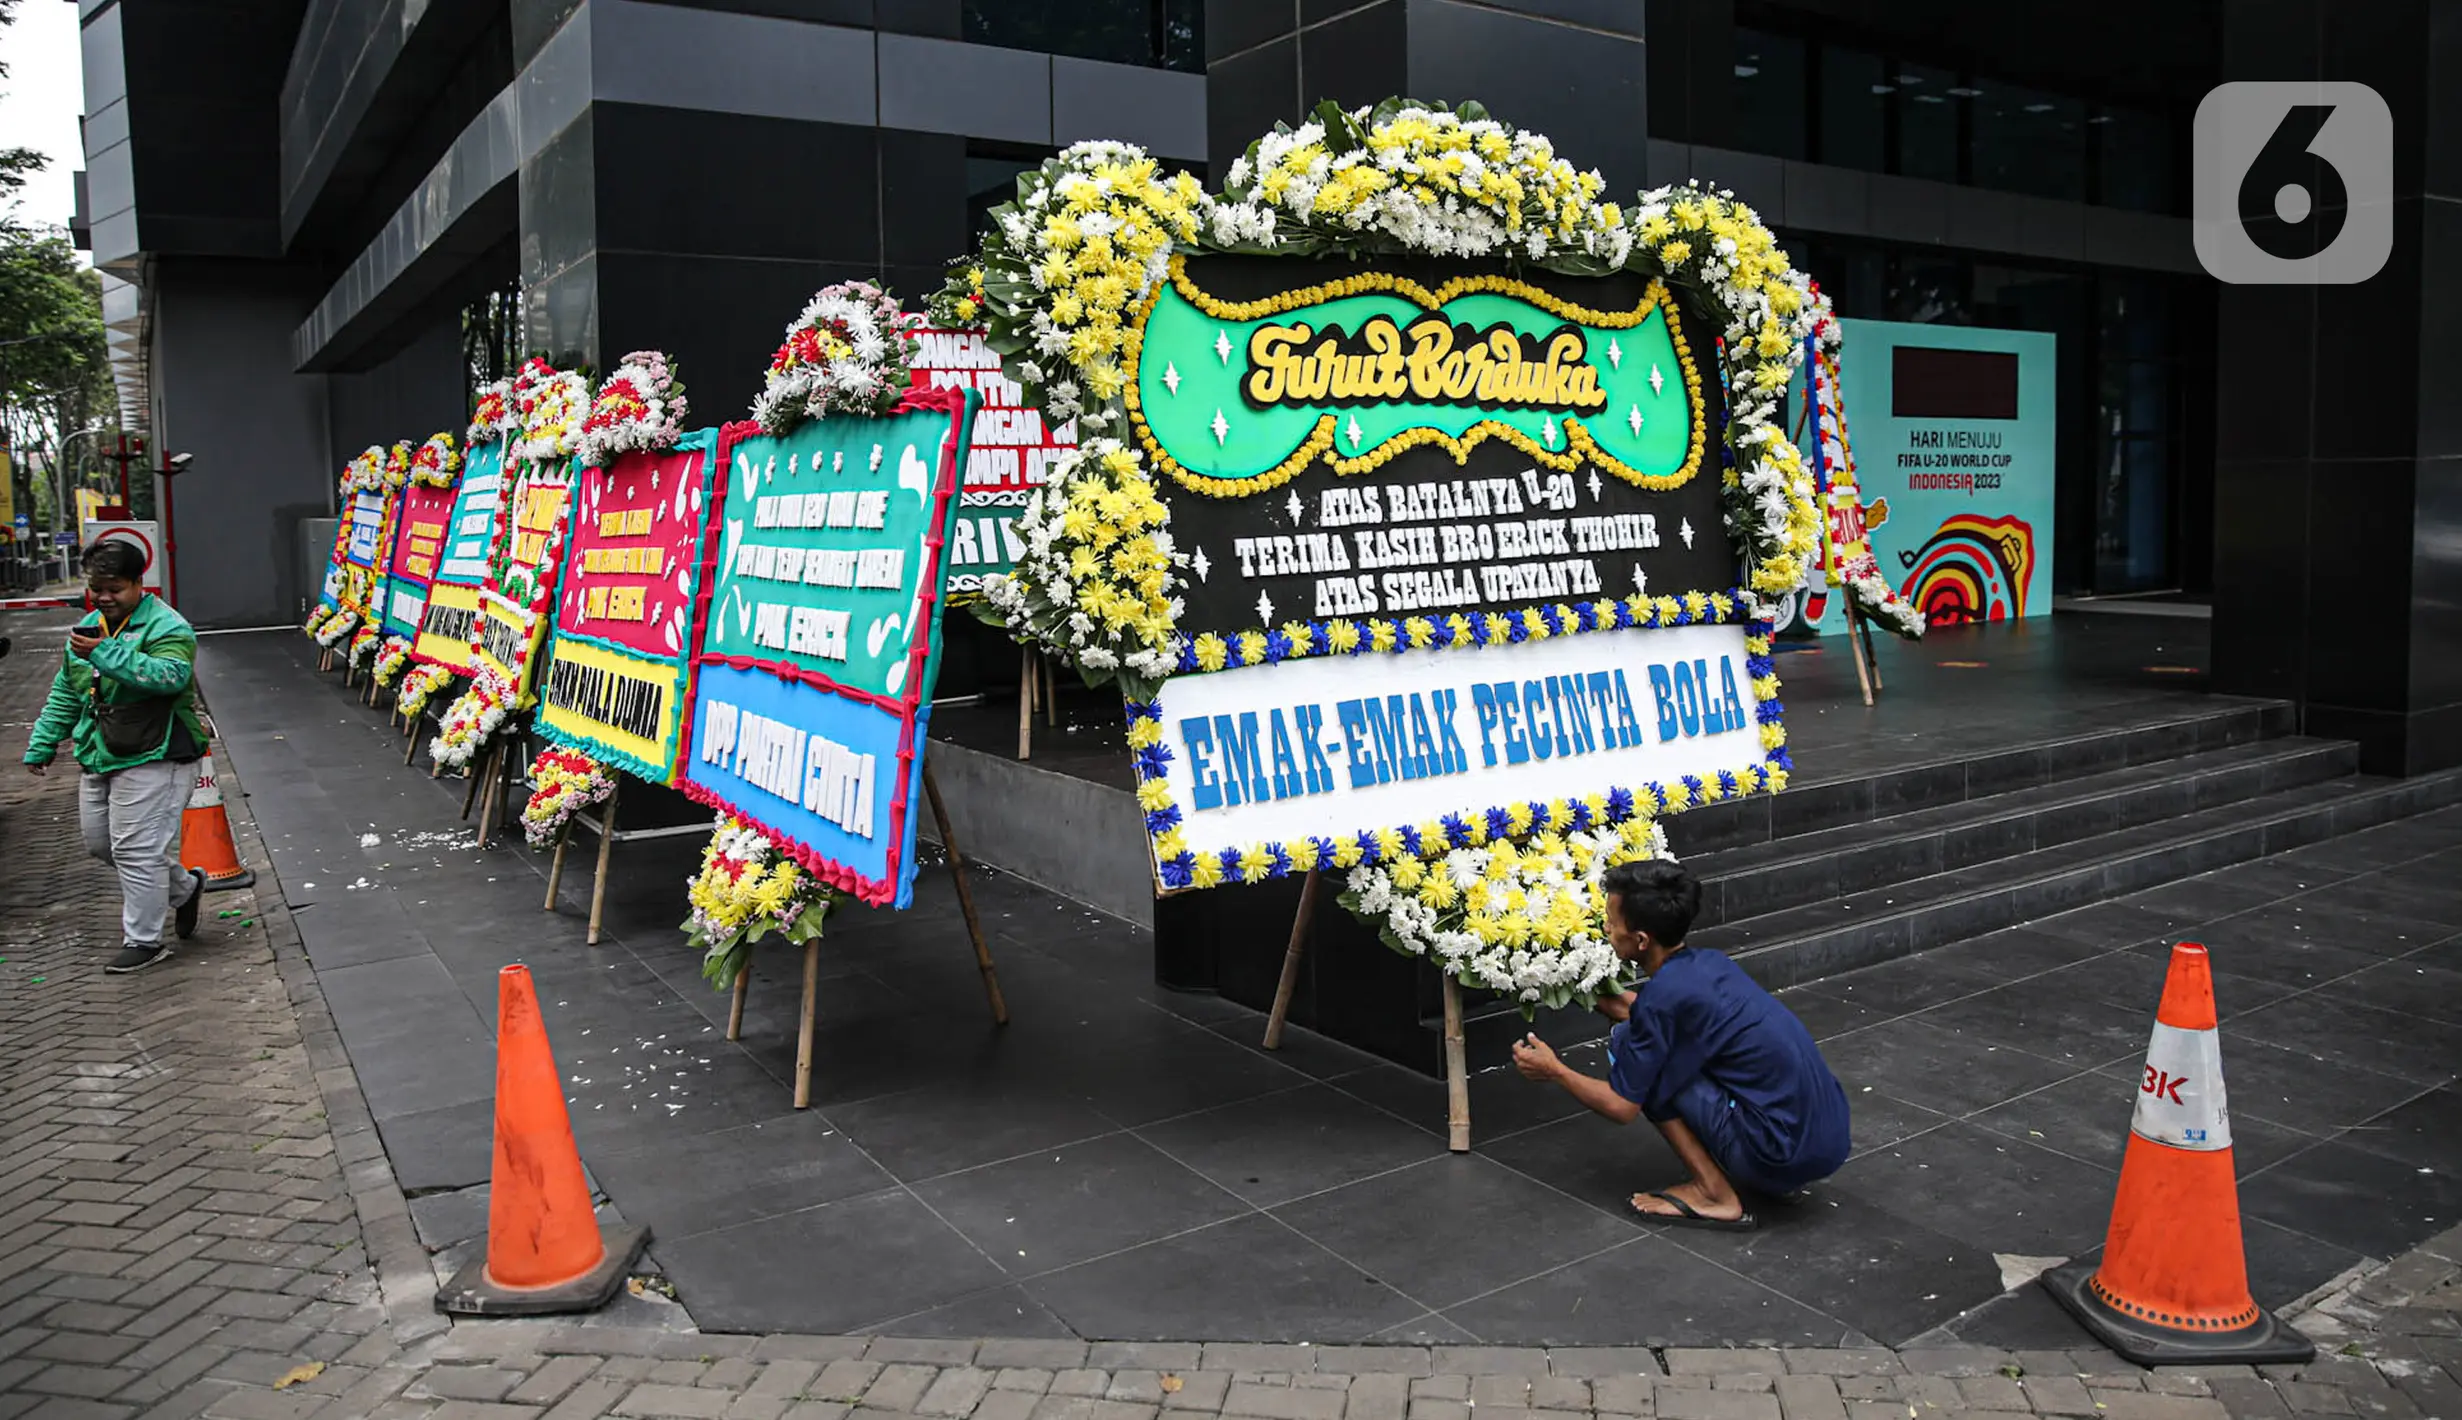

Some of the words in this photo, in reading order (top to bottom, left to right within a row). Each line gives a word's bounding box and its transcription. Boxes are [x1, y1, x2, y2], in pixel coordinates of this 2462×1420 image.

[1250, 319, 1408, 403] Turut
[1406, 319, 1607, 407] Berduka
[1897, 454, 1922, 467] FIFA
[1924, 454, 1949, 467] U-20
[1951, 454, 1989, 467] WORLD
[1991, 454, 2012, 467] CUP
[1910, 431, 1943, 448] HARI
[1947, 431, 2001, 449] MENUJU
[1319, 487, 1383, 527] ATAS
[1385, 478, 1523, 523] BATALNYA
[1521, 468, 1577, 510] U-20
[1909, 473, 1973, 497] INDONESIA
[1974, 474, 2001, 489] 2023
[1234, 533, 1350, 578] TERIMA
[1355, 526, 1439, 569] KASIH
[1439, 523, 1494, 564] BRO
[1494, 518, 1571, 559] ERICK
[1571, 513, 1660, 553] THOHIR
[1314, 575, 1379, 617] ATAS
[1383, 568, 1480, 611] SEGALA
[1479, 559, 1601, 604] UPAYANYA
[612, 675, 663, 742] DUNIA
[1180, 688, 1469, 812] EMAK-EMAK
[1471, 668, 1643, 768] PECINTA
[1648, 655, 1747, 744] BOLA
[734, 710, 807, 806] PARTAI
[803, 735, 876, 840] CINTA
